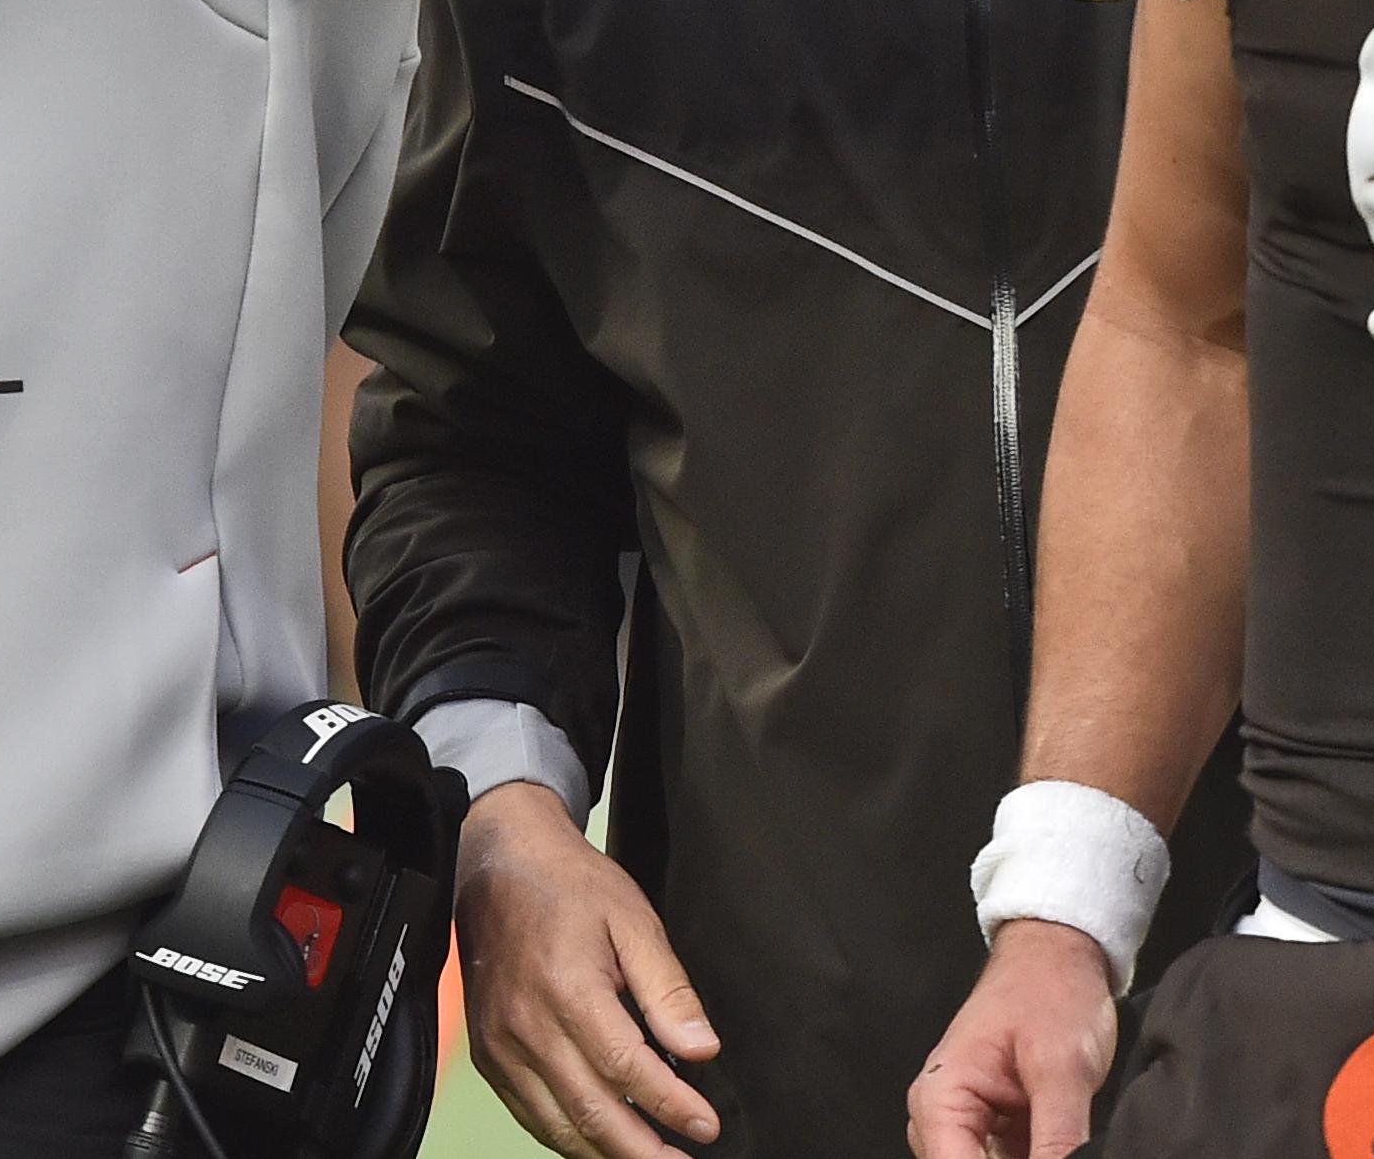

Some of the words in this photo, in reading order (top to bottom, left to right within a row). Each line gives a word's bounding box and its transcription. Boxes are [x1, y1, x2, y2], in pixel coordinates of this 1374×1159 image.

[301, 704, 383, 764] BO
[135, 947, 265, 990] BOSE
[354, 923, 409, 1109] BOSE
